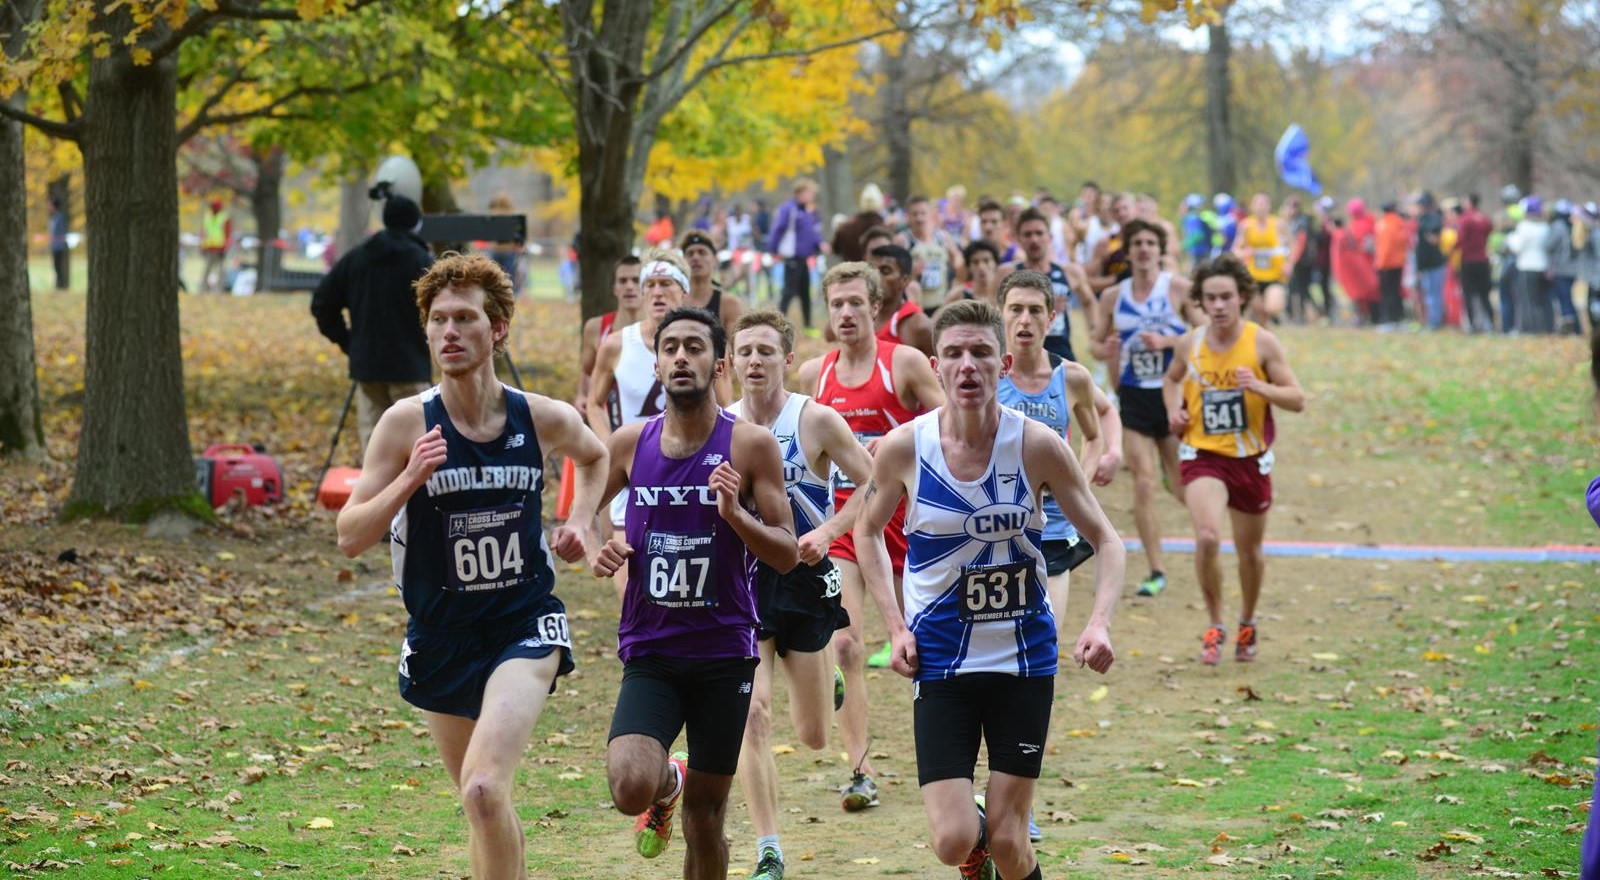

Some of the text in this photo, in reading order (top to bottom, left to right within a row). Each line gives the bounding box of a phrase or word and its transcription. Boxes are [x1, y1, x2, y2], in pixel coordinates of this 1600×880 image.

[1205, 402, 1244, 430] 541
[425, 465, 542, 497] MIDDLEBURY
[635, 485, 721, 506] NYU
[468, 514, 491, 525] CROSS
[492, 510, 522, 522] COUNTRY
[974, 511, 1027, 534] CNU
[683, 537, 712, 546] COUNTRY
[454, 531, 524, 582] 604
[465, 582, 496, 592] NOVEMBER
[649, 556, 710, 599] 647
[966, 567, 1027, 611] 531
[973, 613, 1003, 621] NOVEMBER
[1012, 609, 1025, 617] 2016
[543, 615, 569, 643] 60
